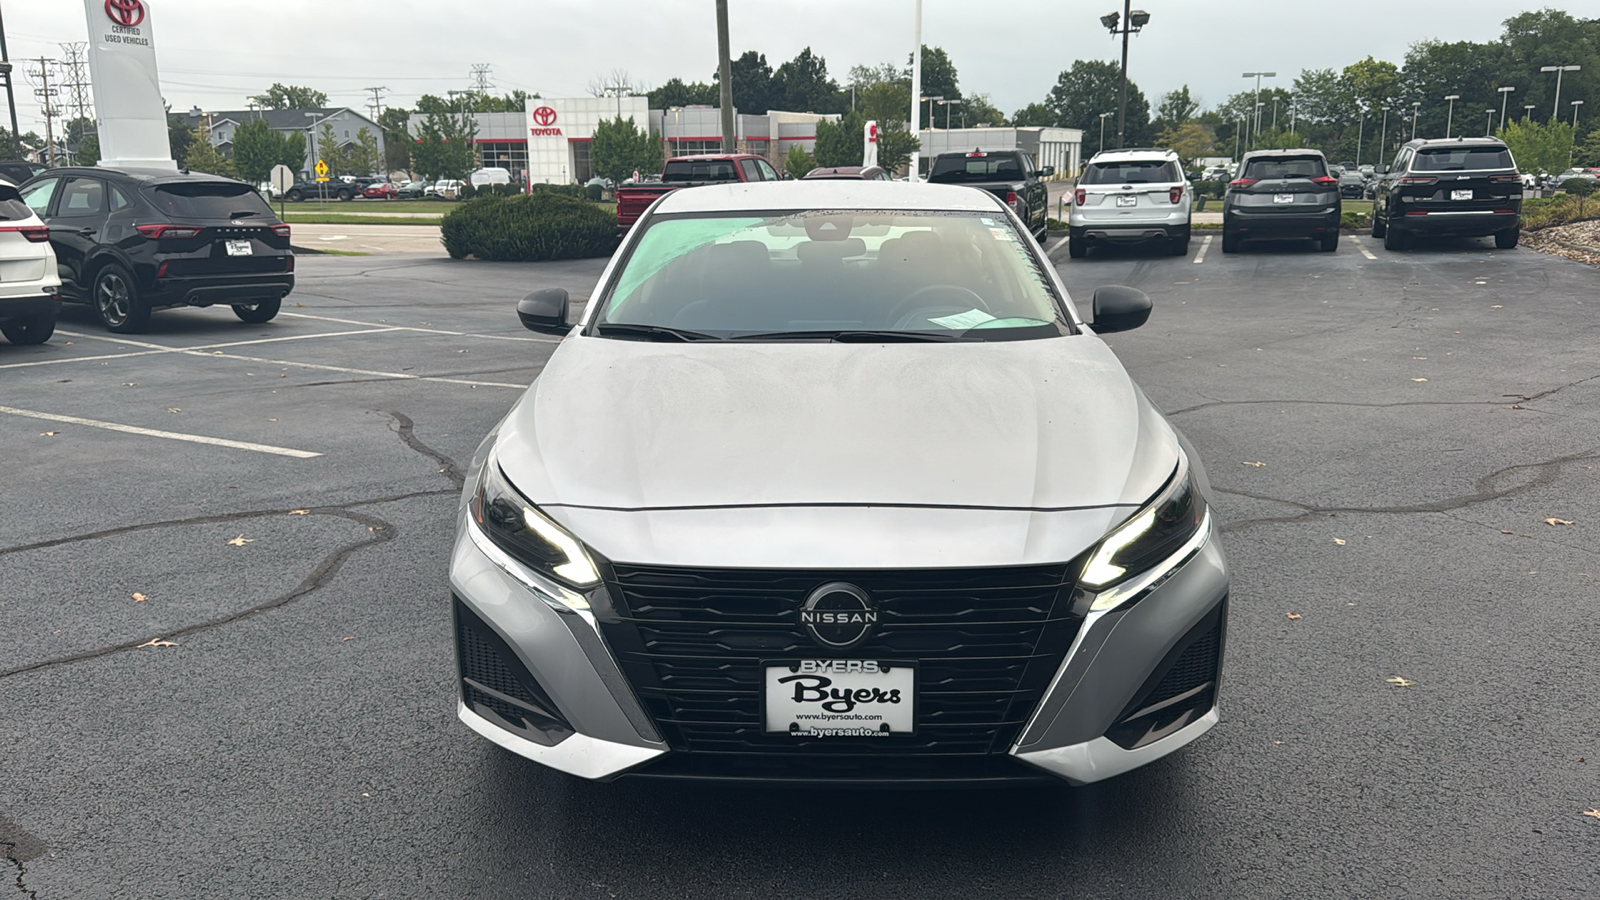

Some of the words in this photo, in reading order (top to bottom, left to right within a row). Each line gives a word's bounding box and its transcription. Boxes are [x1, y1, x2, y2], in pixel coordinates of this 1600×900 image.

[112, 25, 140, 35] CERTIFIED
[105, 34, 121, 43] USED
[122, 36, 149, 46] VEHICLES
[530, 128, 562, 136] TOYOTA
[801, 612, 878, 624] NISSAN
[800, 660, 879, 673] BYERS
[778, 674, 901, 713] Byers
[796, 713, 882, 721] www.byersauto.com
[791, 727, 889, 738] www.byersauto.com
